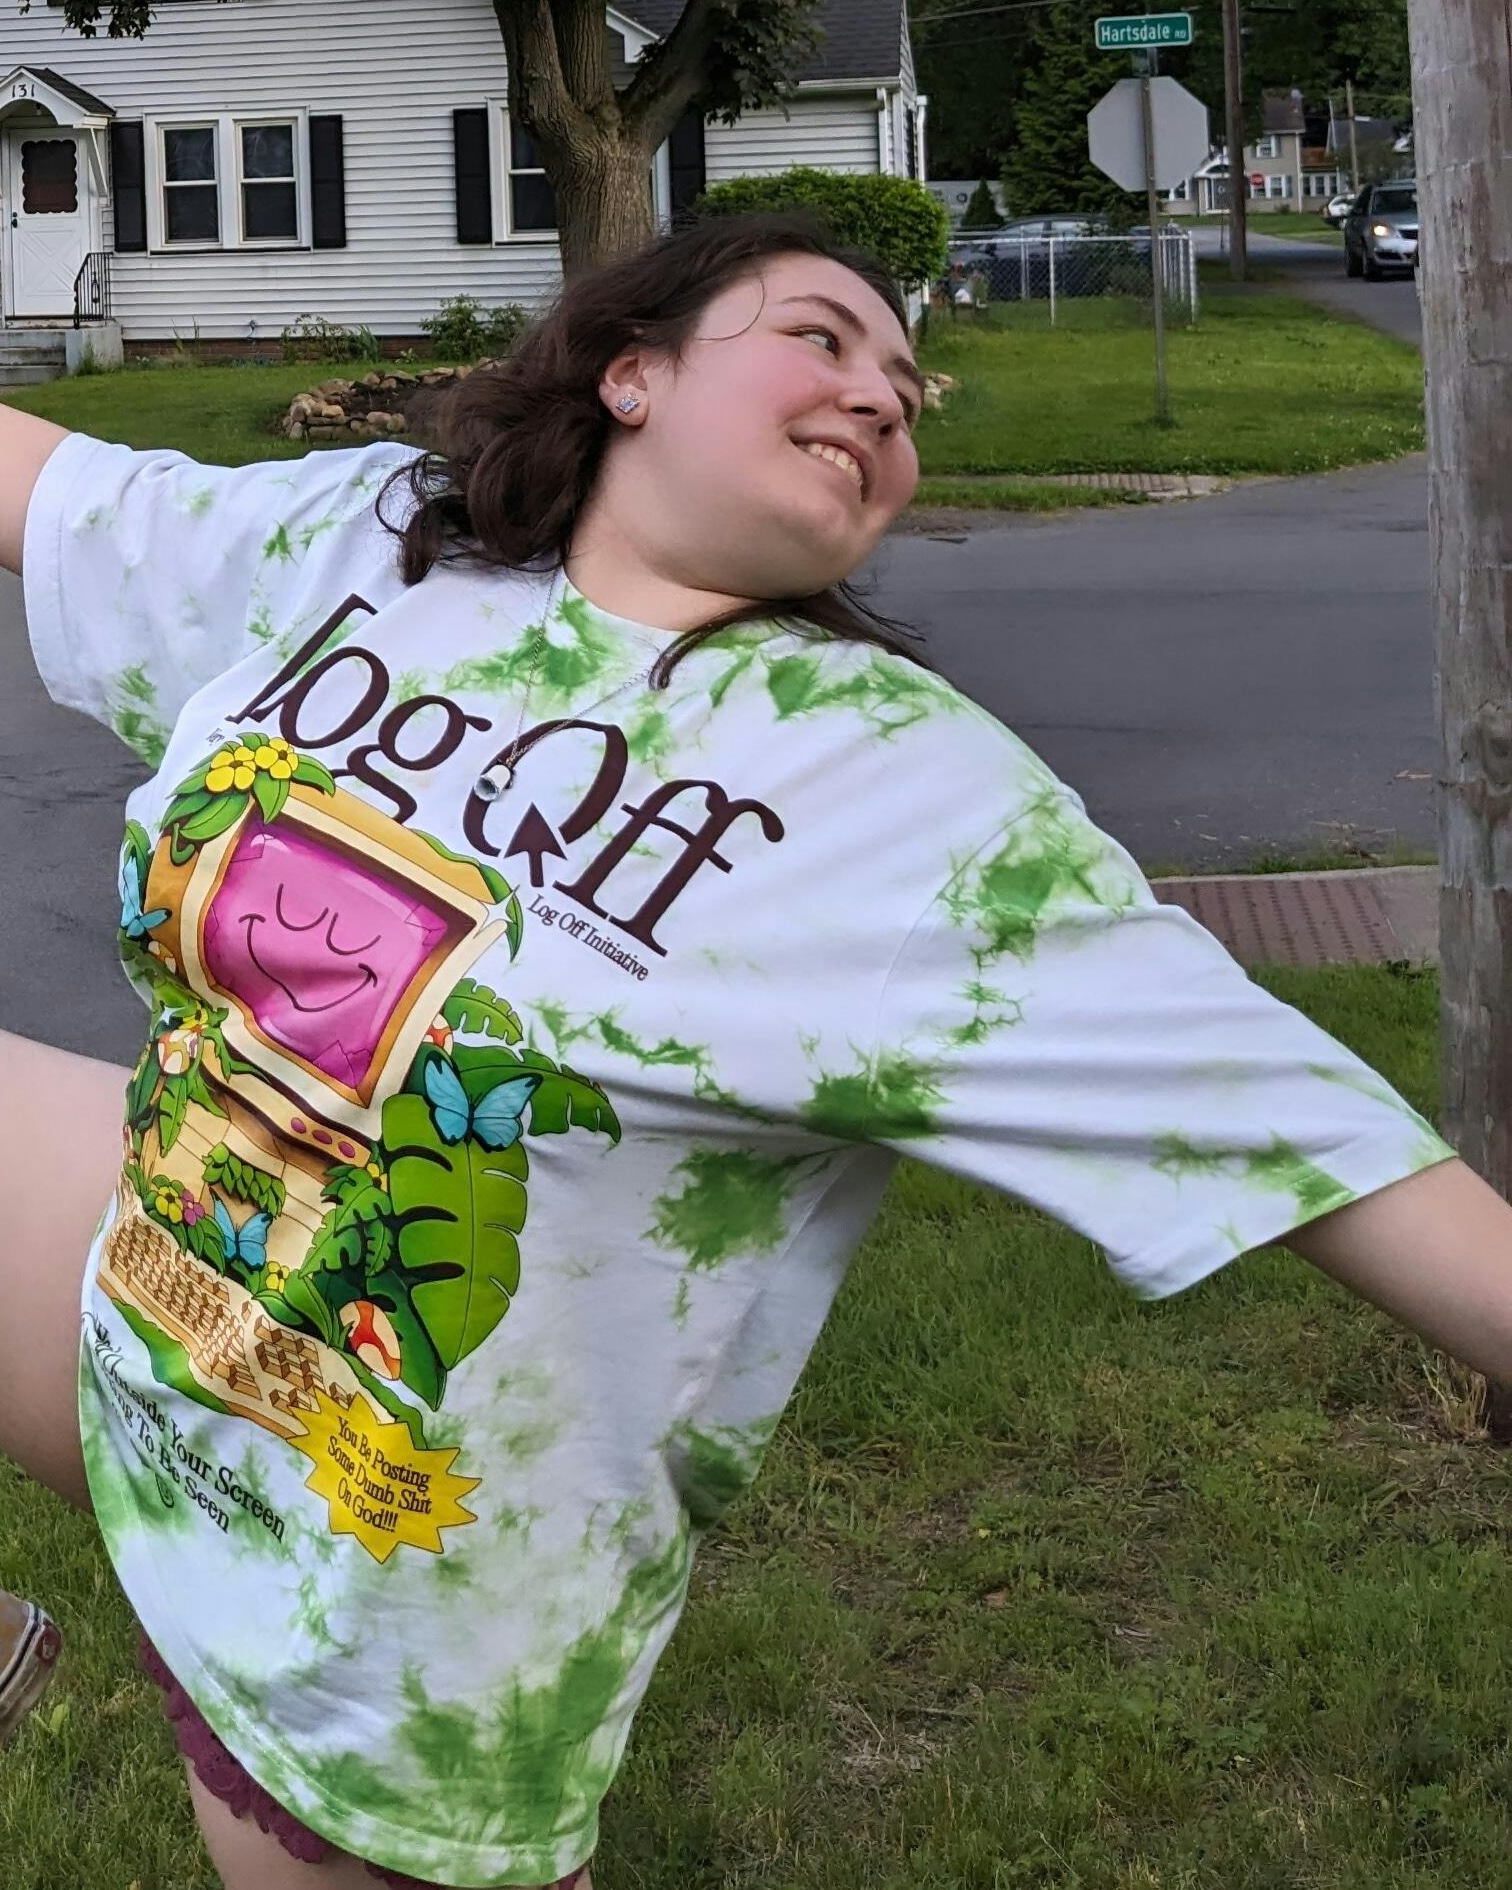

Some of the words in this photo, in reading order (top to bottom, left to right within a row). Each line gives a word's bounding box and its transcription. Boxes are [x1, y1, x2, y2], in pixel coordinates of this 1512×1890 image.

[1100, 23, 1170, 43] Hartsdale
[12, 83, 35, 98] 131
[526, 894, 560, 926] Log
[558, 912, 590, 939] Off
[581, 925, 649, 982] Initiative
[137, 1412, 155, 1454] To
[159, 1442, 180, 1483] Be
[184, 1475, 230, 1534] Seen
[171, 1418, 212, 1481] Your
[215, 1466, 285, 1544] Screen
[328, 1435, 355, 1476] Some
[354, 1462, 394, 1505] Dumb
[398, 1489, 432, 1514] Shit
[338, 1415, 357, 1448] You
[358, 1433, 372, 1462] Be
[372, 1448, 431, 1492] Posting
[338, 1477, 352, 1508] On
[352, 1495, 399, 1532] God!!!
